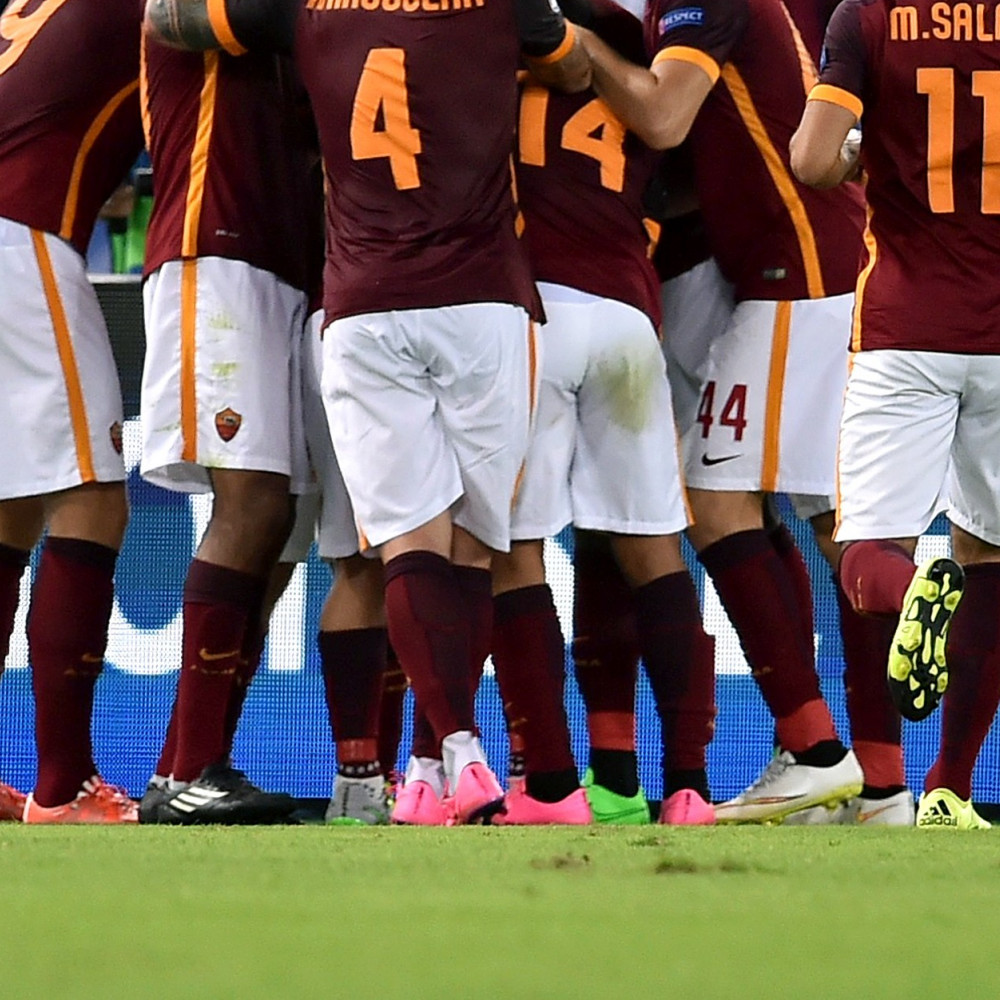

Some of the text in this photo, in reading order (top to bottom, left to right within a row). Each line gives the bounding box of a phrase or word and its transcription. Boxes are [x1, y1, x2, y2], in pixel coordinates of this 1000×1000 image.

[664, 11, 703, 25] RESPECT
[890, 2, 1000, 42] M.SAL
[350, 47, 422, 190] 4
[517, 69, 627, 193] 14
[916, 67, 1000, 215] 11
[697, 381, 748, 442] 44
